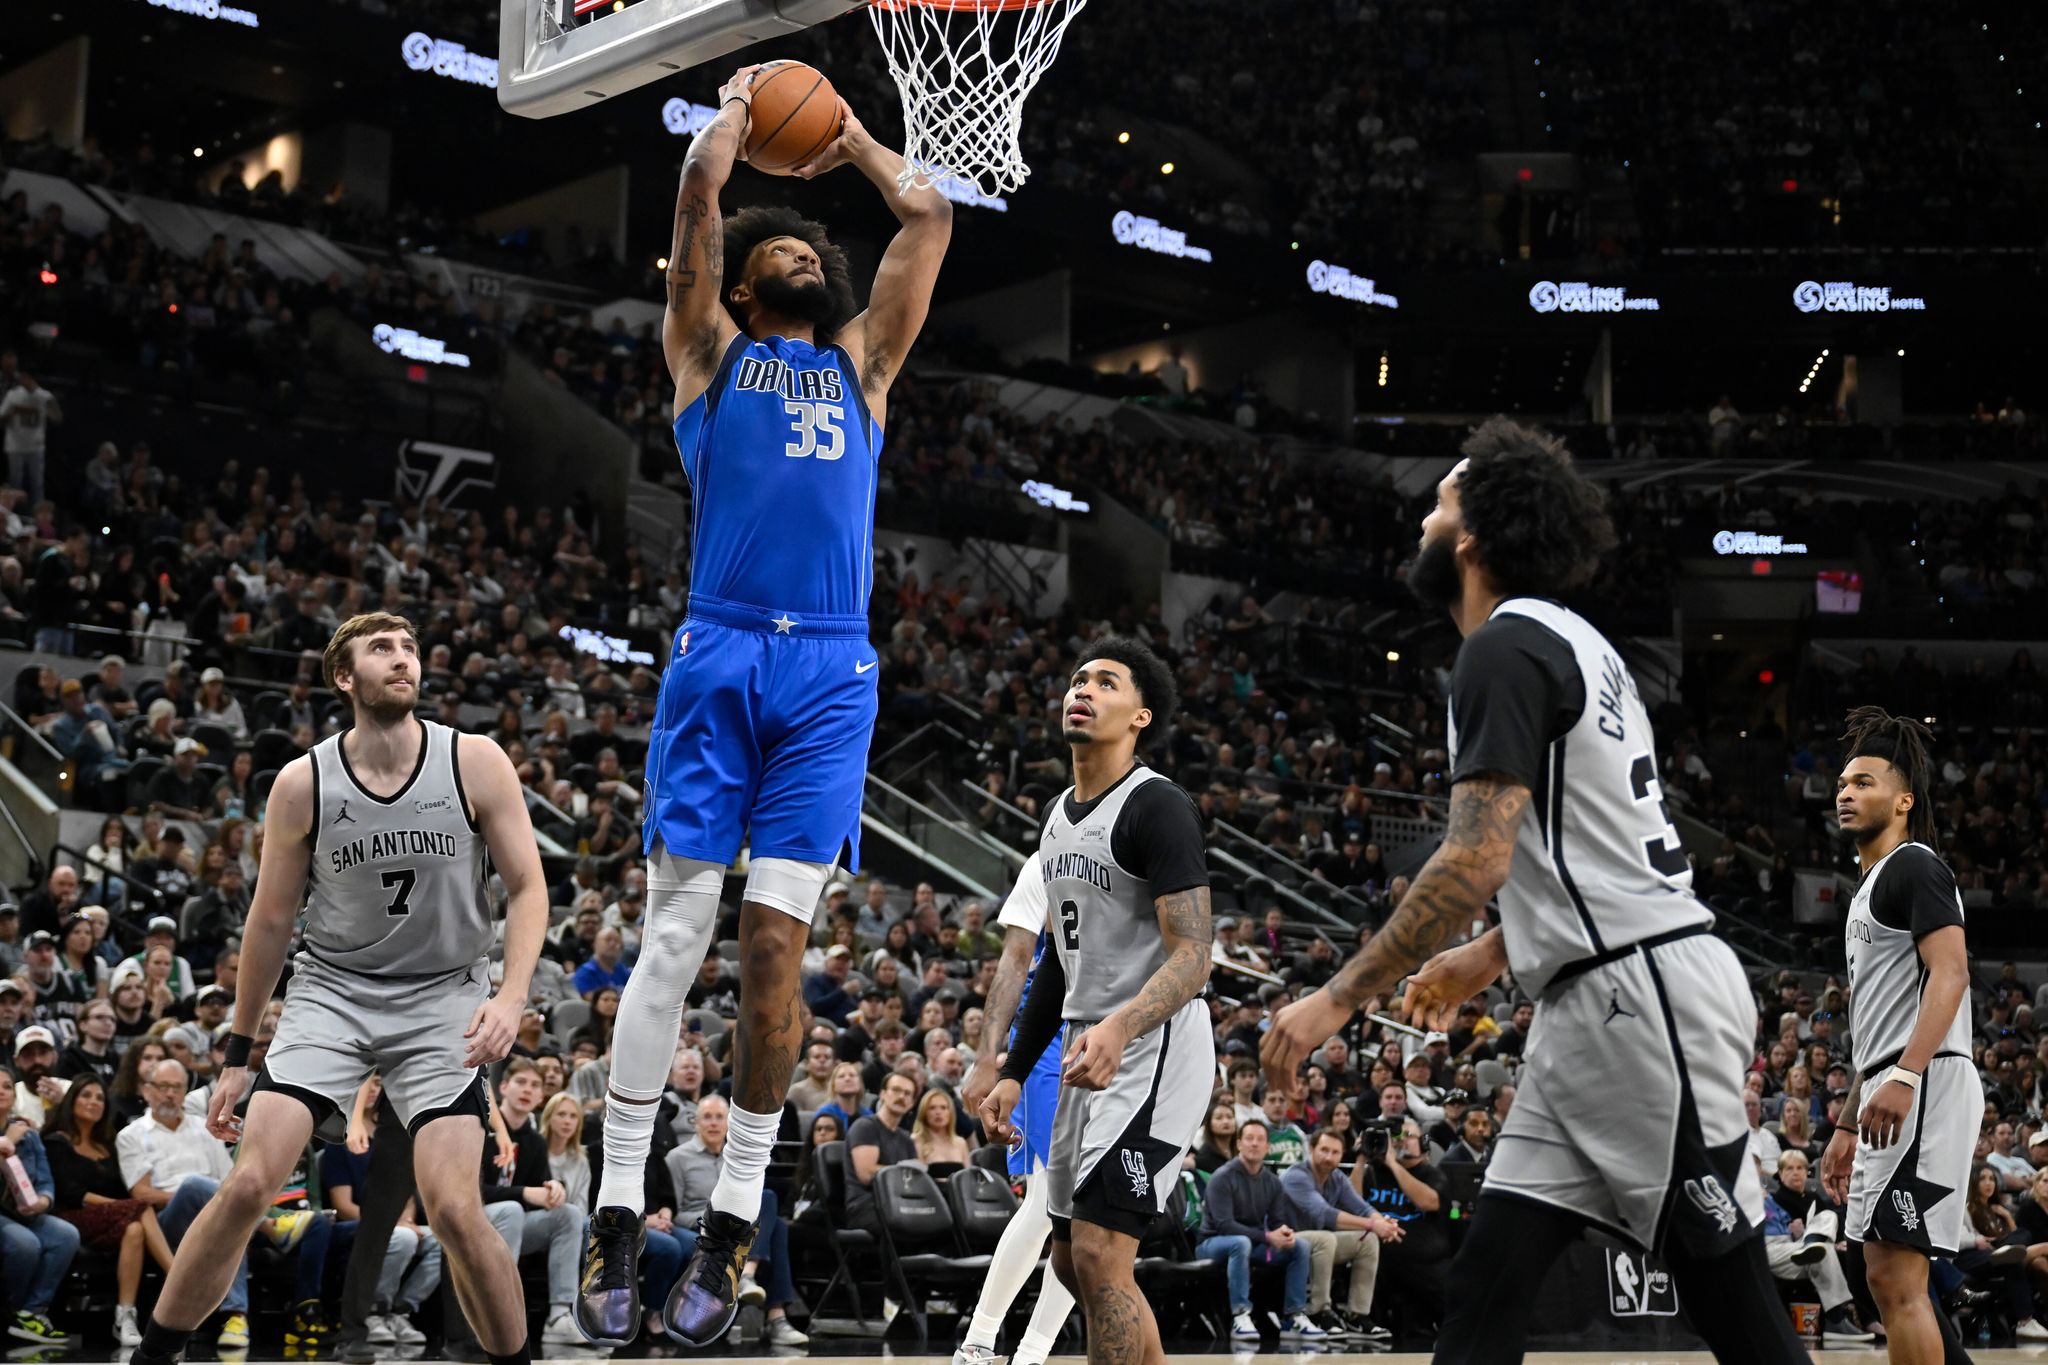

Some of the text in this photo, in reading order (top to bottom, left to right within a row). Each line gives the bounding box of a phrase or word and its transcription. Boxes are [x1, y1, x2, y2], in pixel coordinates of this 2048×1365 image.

[1559, 298, 1660, 312] CASINO HOTEL
[1824, 297, 1926, 312] CASINO HOTEL
[736, 357, 843, 402] DALLAS
[785, 401, 846, 461] 35
[420, 800, 447, 811] LEDGER
[331, 829, 457, 875] SAN ANTONIO
[1084, 829, 1102, 838] LEDGER
[380, 867, 417, 917] 7
[1055, 851, 1112, 894] ANTONIO
[1060, 899, 1080, 951] 2
[1647, 1269, 1669, 1285] prime
